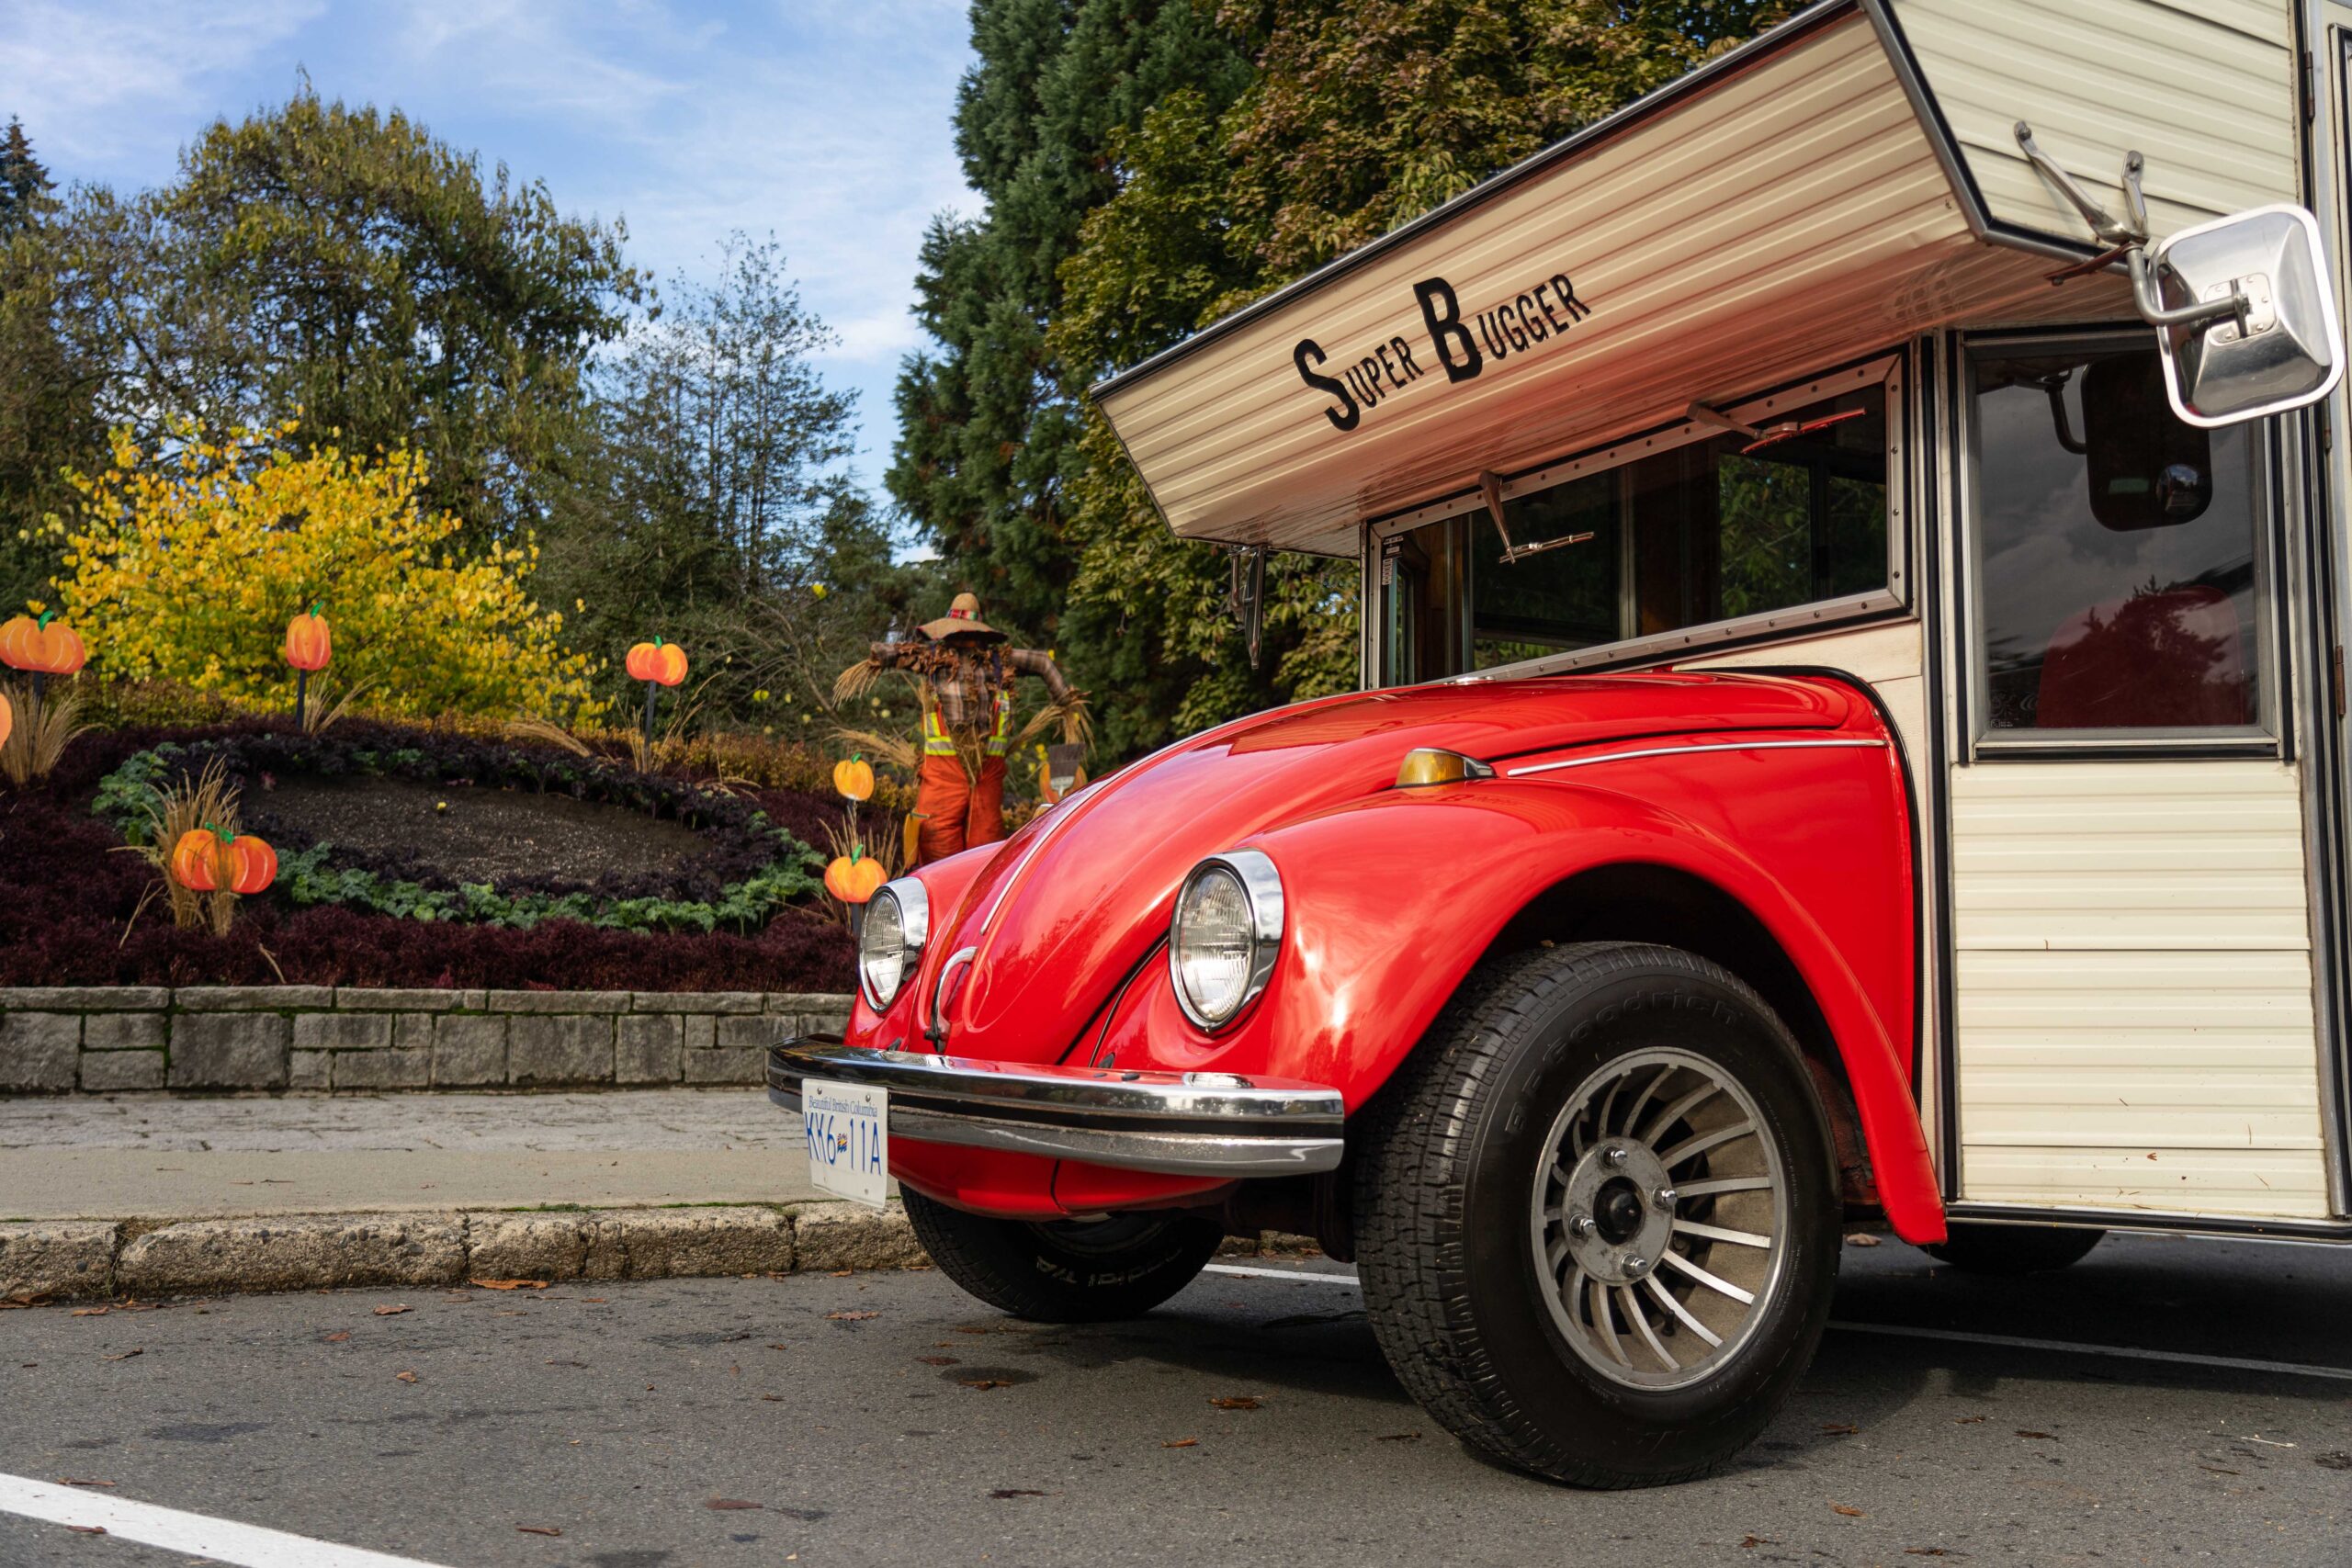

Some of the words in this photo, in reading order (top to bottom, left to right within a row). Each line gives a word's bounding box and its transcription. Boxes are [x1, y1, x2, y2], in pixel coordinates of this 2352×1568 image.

[1293, 335, 1425, 432] SUPER
[1412, 274, 1592, 384] BUGGER
[808, 1095, 831, 1111] Beautiful
[831, 1098, 849, 1113] British
[850, 1100, 877, 1117] Columbia
[805, 1111, 836, 1167] KK6
[850, 1118, 882, 1177] 11A
